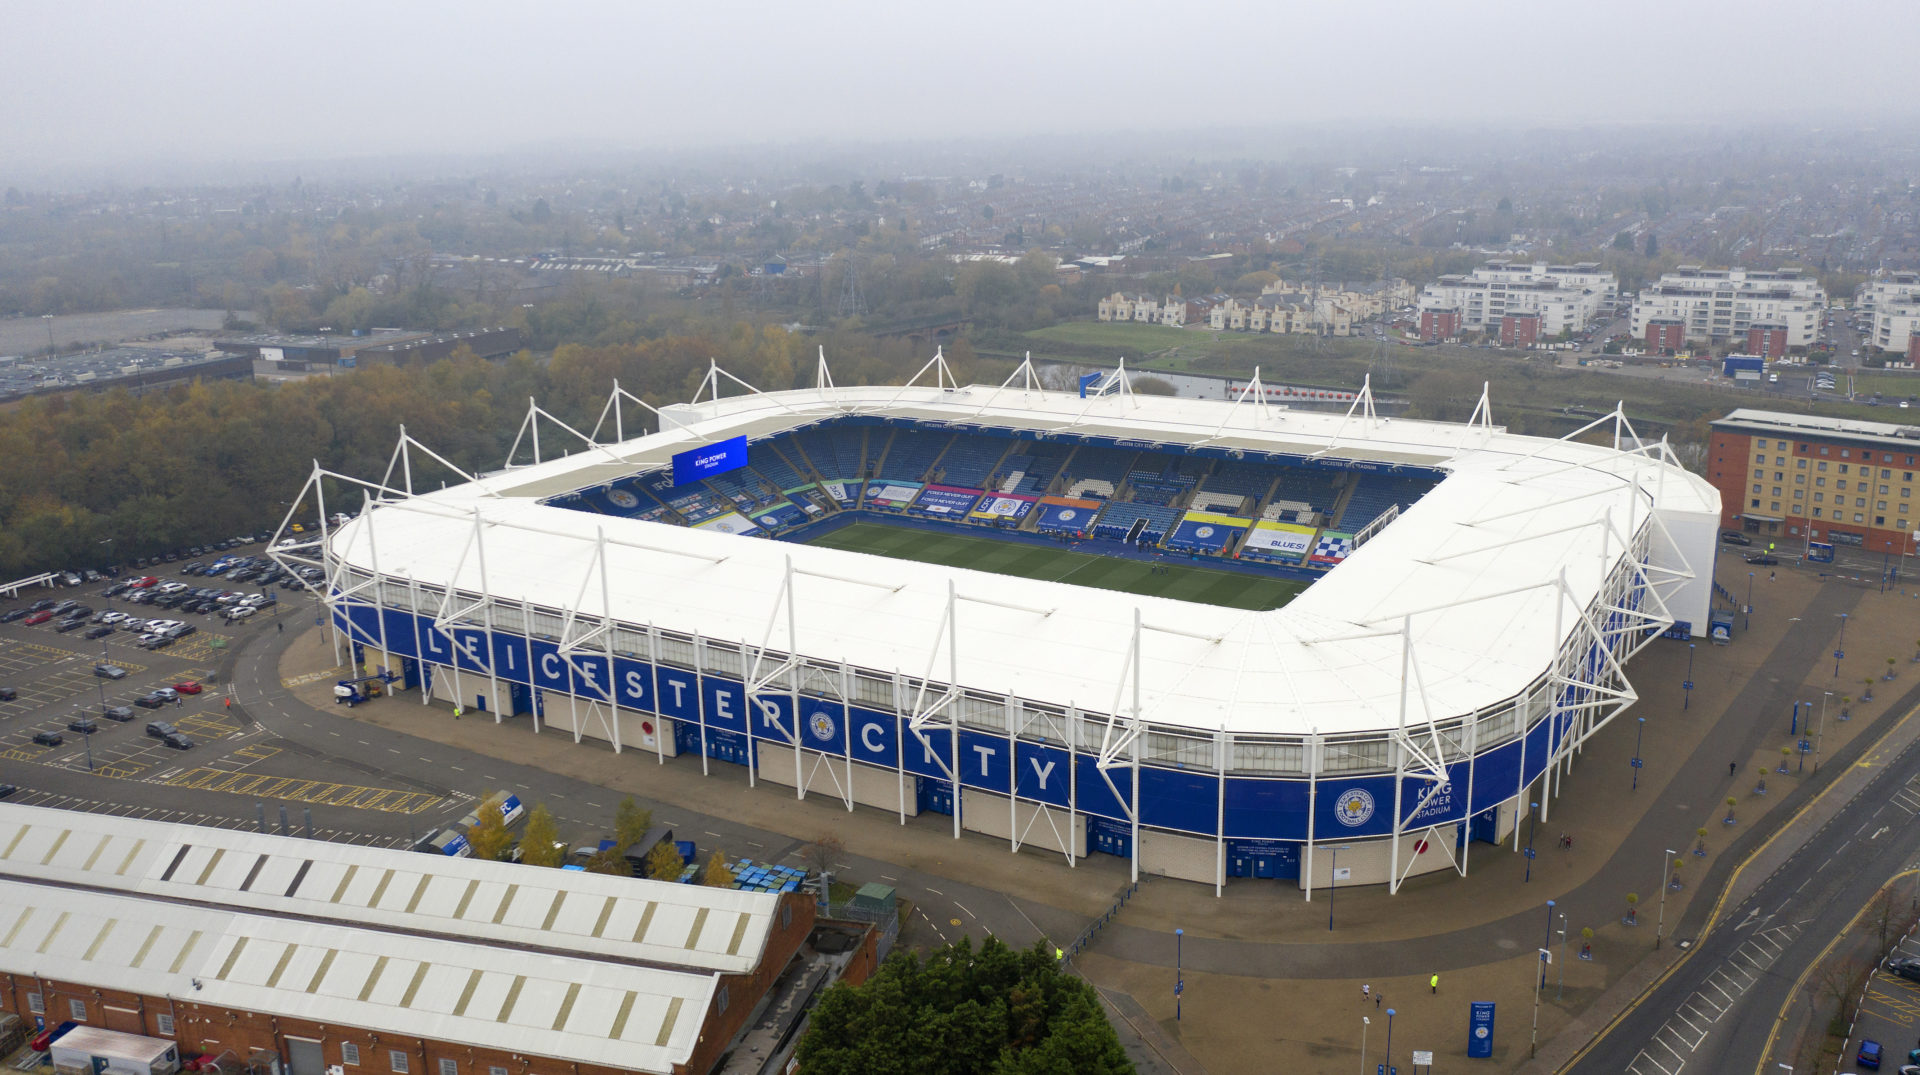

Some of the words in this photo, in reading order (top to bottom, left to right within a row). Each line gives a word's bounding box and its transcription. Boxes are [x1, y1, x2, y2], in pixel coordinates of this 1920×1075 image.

[695, 457, 709, 467] KING
[709, 452, 727, 463] POWER
[1270, 540, 1306, 550] BLUES!
[427, 627, 781, 730] LEICESTER
[861, 722, 1056, 790] CITY
[1416, 806, 1451, 819] STADIUM
